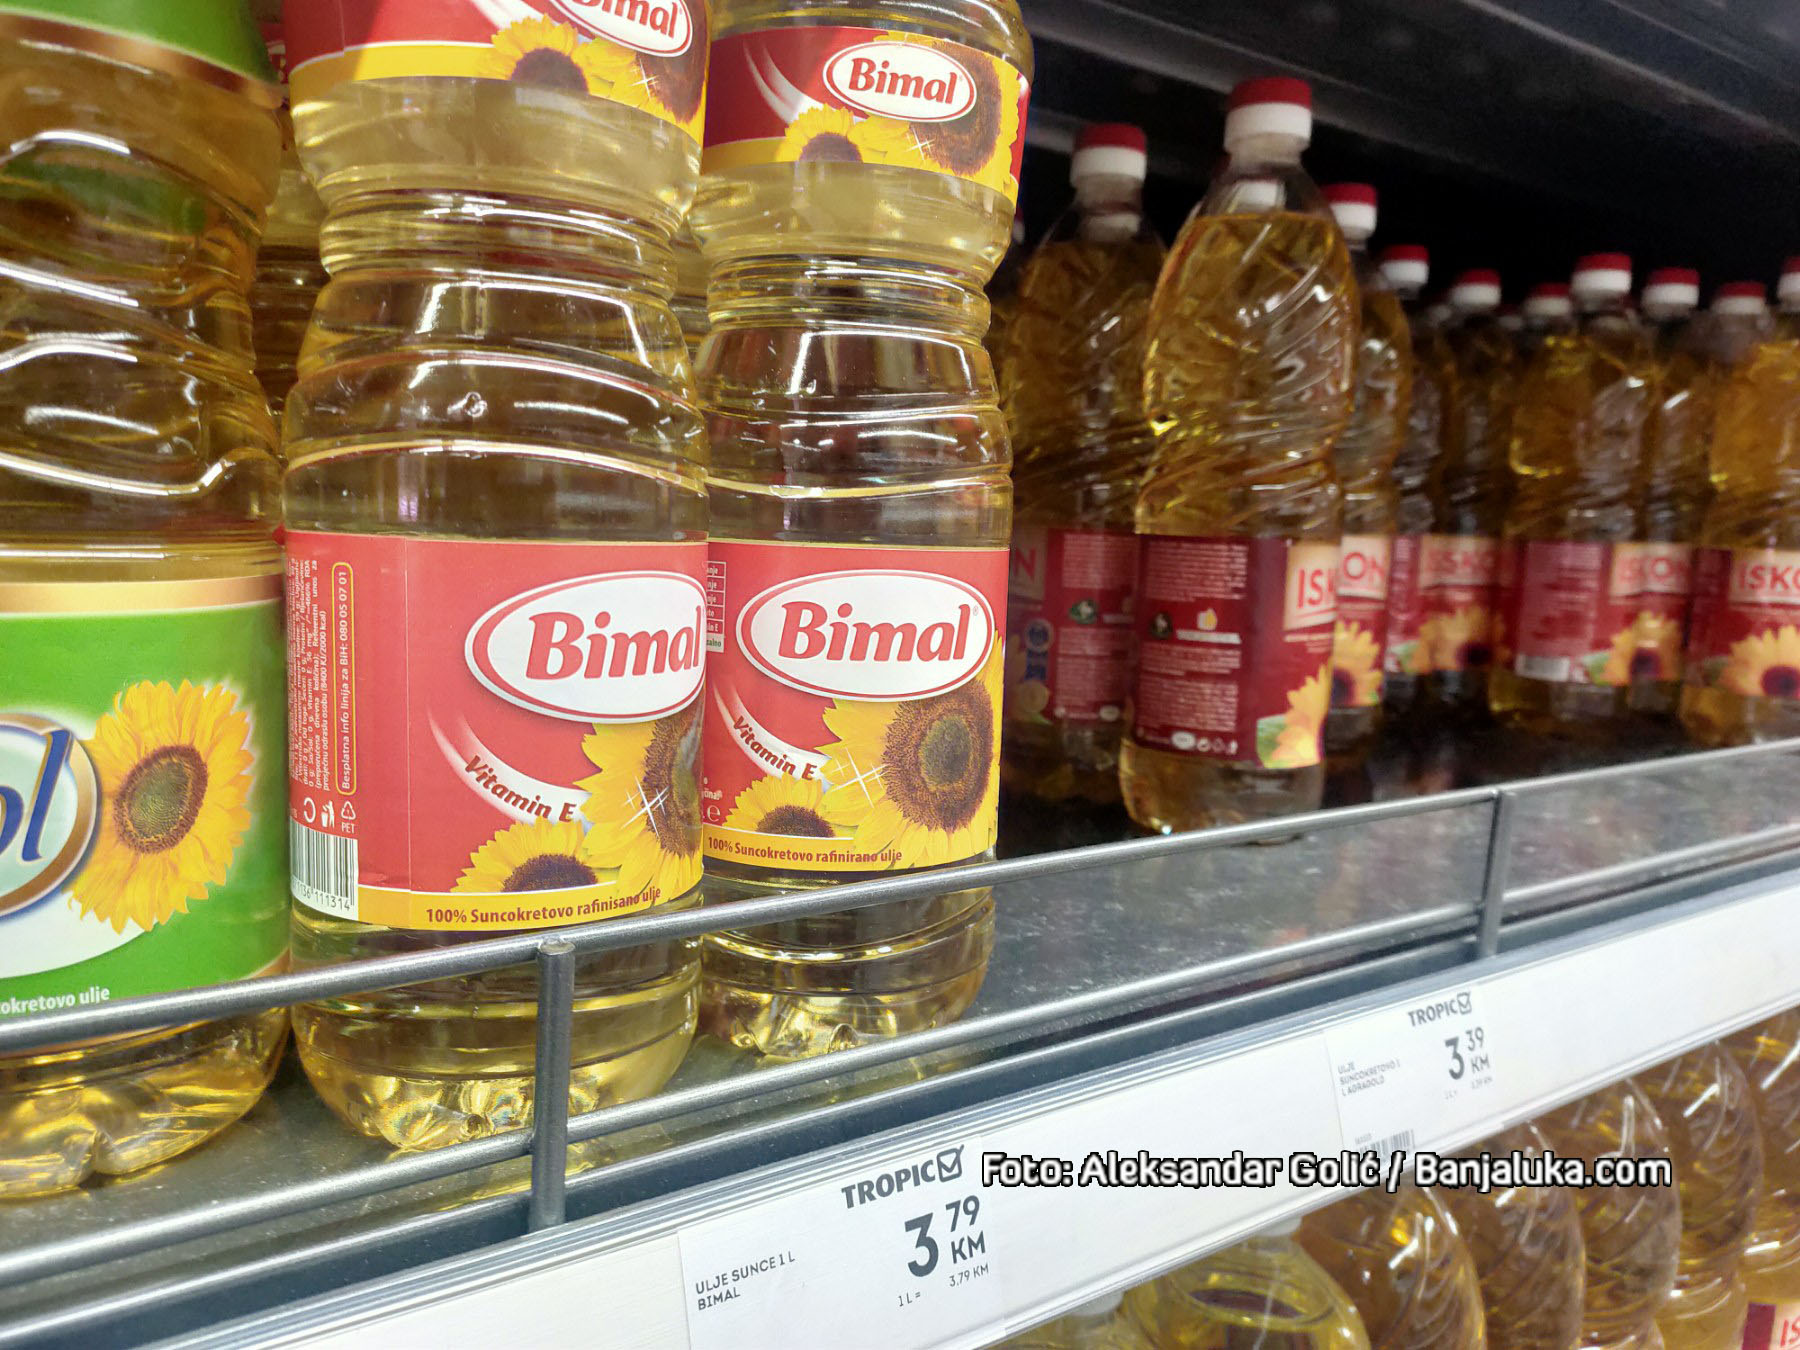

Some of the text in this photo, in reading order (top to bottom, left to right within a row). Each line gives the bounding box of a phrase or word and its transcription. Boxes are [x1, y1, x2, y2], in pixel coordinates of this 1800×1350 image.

[848, 57, 958, 104] Bimal
[525, 605, 702, 681] Bimal
[779, 601, 971, 663] Bimal
[338, 572, 352, 789] Besplatna info linija za BiH: 080 05 07 01
[732, 715, 819, 781] Vitamin E
[464, 755, 578, 822] Vitamin E
[341, 822, 355, 834] PET
[708, 836, 902, 864] 100% Suncokretovo rafinirano ulje
[426, 886, 661, 923] 100% Suncokretovo rafinisano ulje
[1407, 999, 1458, 1028] TROPIC
[1444, 1026, 1484, 1080] 3 39
[1470, 1053, 1490, 1074] KM
[841, 1159, 936, 1209] TROPIC
[904, 1195, 980, 1278] 3 79
[951, 1230, 986, 1264] KM
[696, 1250, 796, 1295] ULJE SUNCE 1 L
[973, 1262, 989, 1278] KM
[698, 1286, 741, 1311] BIMAL
[898, 1294, 904, 1307] 1
[906, 1292, 913, 1305] L
